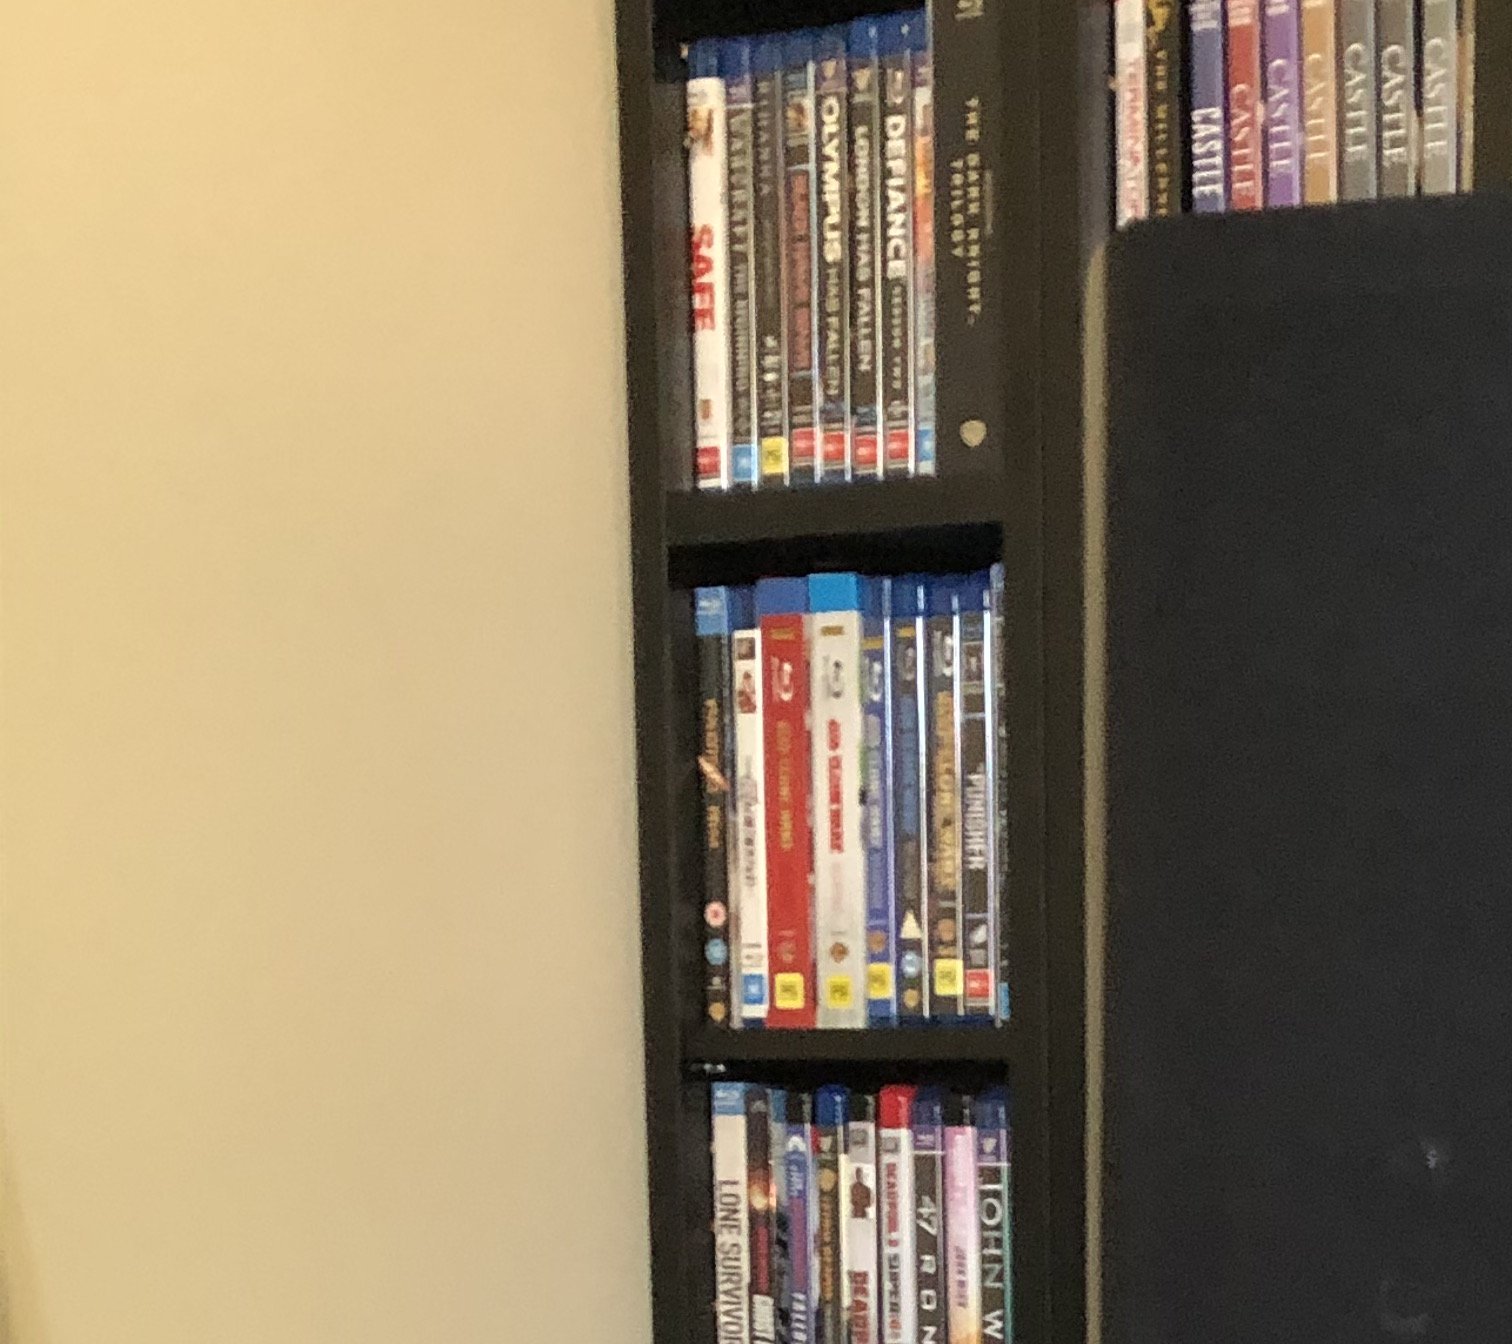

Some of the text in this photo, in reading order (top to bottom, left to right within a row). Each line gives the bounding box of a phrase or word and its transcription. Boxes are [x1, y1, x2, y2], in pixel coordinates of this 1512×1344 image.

[1190, 107, 1223, 198] CASTLE
[1231, 83, 1254, 196] CASTLE
[1268, 58, 1291, 175] CASTLE
[1306, 53, 1328, 161] CASTLE
[1344, 42, 1367, 163] CASTLE
[1381, 44, 1407, 168] CASTLE
[1423, 38, 1447, 160] CASTLE
[821, 99, 842, 262] OLYMPUS
[885, 113, 906, 279] DEFIANCE
[692, 224, 715, 331] SAFE
[854, 125, 872, 371] LONDON HAS FALLEN
[826, 316, 841, 395] FALLEN
[964, 773, 987, 871] PUNISHER
[719, 1179, 738, 1236] LONE
[886, 1162, 899, 1235] DEADPOOL
[917, 1195, 937, 1236] 47
[977, 1182, 1004, 1289] JOHN
